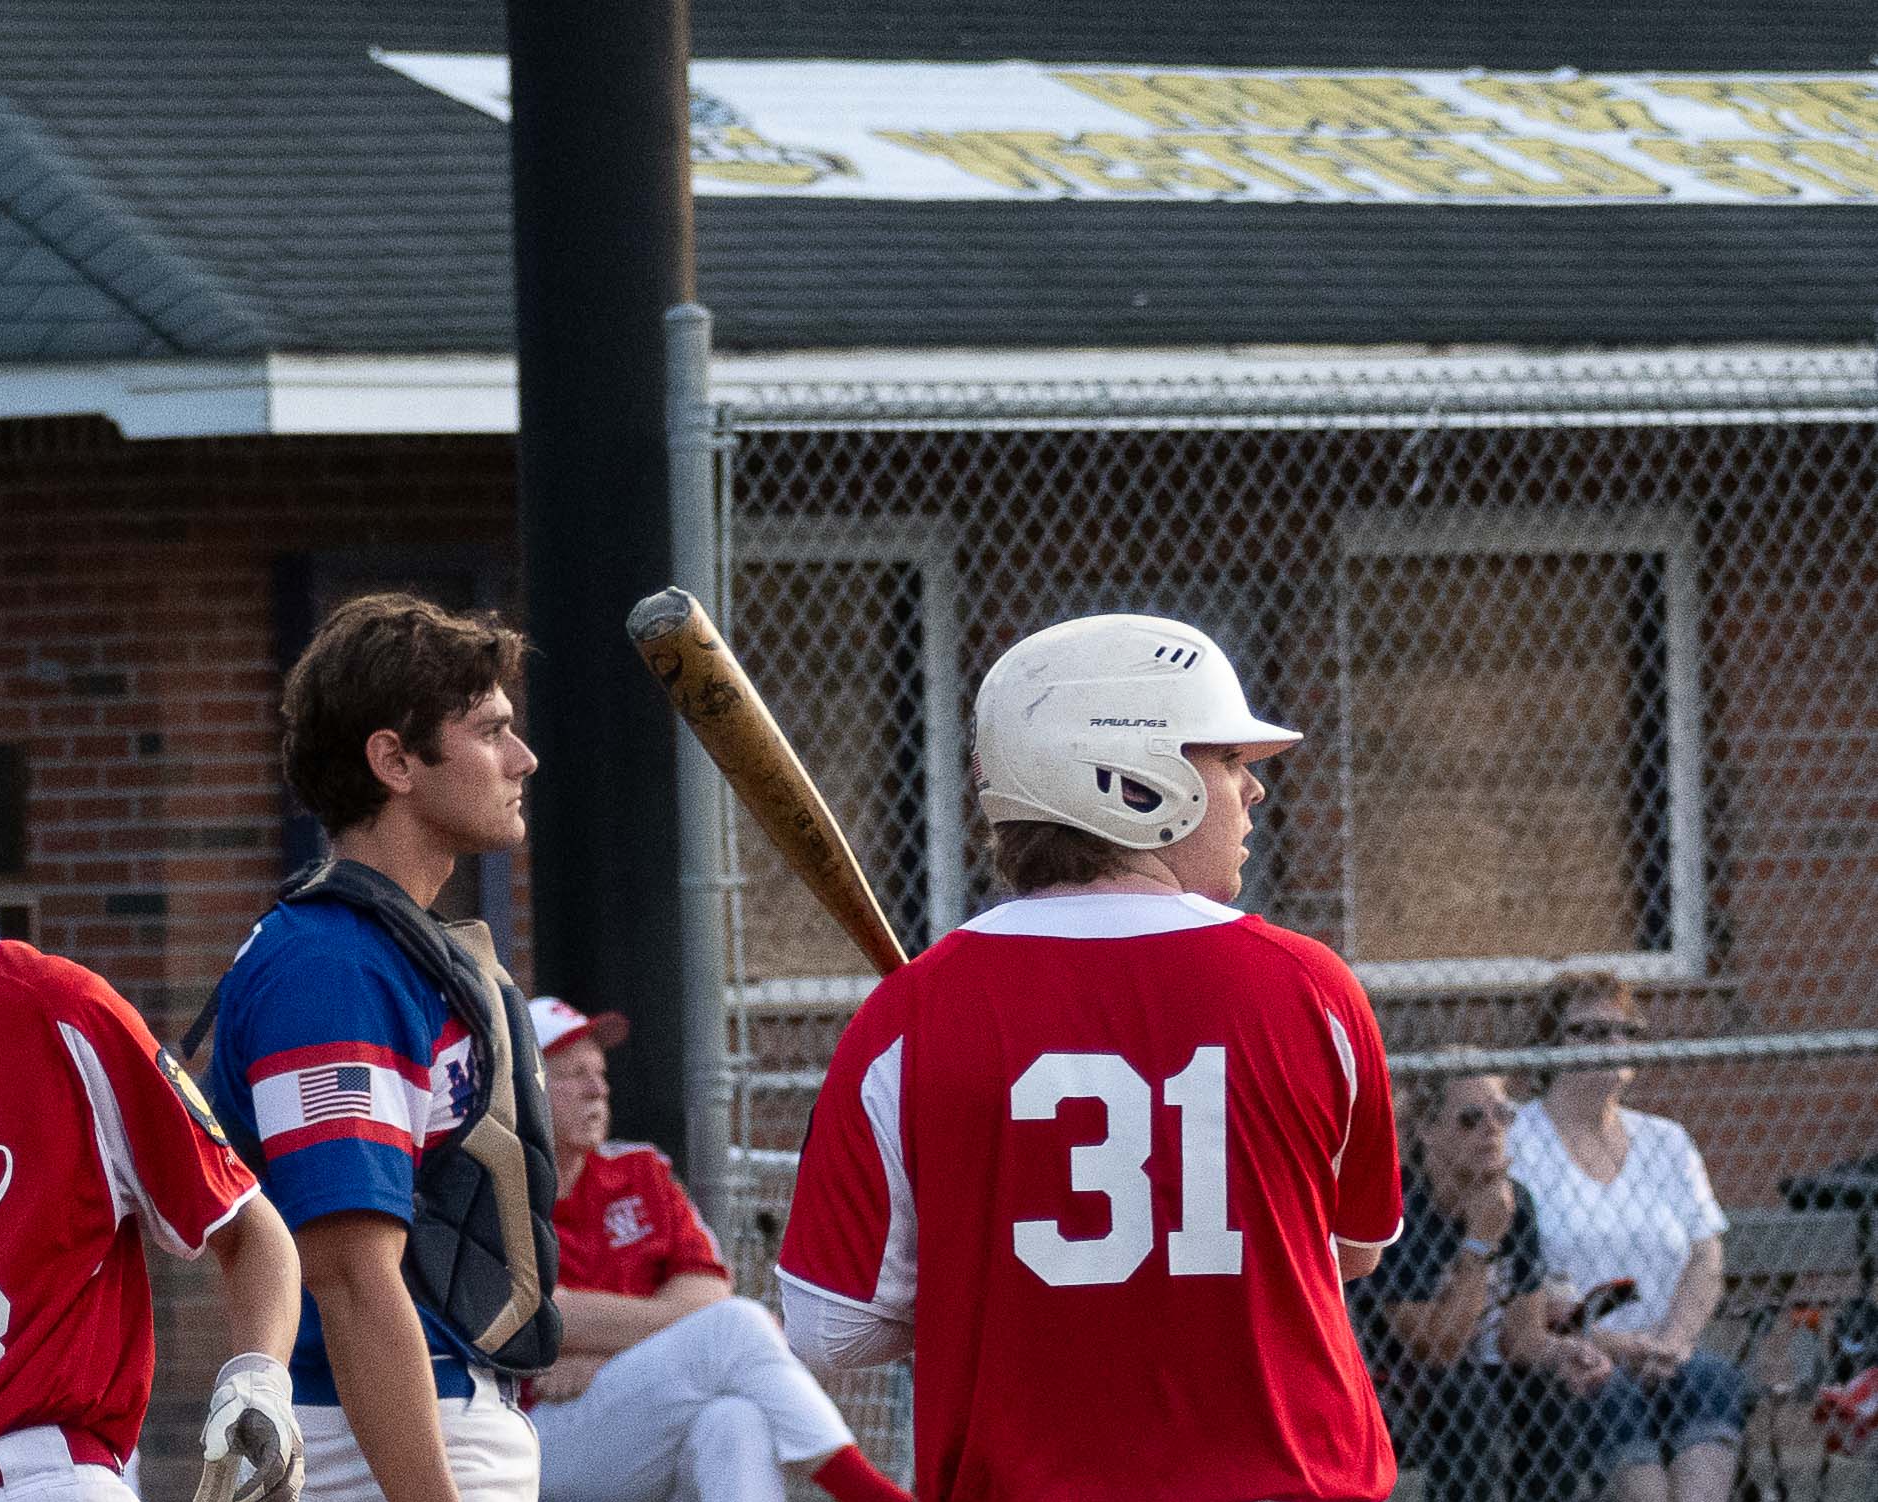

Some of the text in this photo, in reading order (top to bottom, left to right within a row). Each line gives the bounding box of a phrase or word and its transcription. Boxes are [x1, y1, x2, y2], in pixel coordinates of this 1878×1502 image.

[1048, 73, 1500, 134] HOME
[870, 129, 1669, 196] WESTFIELD
[1090, 718, 1166, 728] RAWLINGS
[1011, 1046, 1243, 1287] 31
